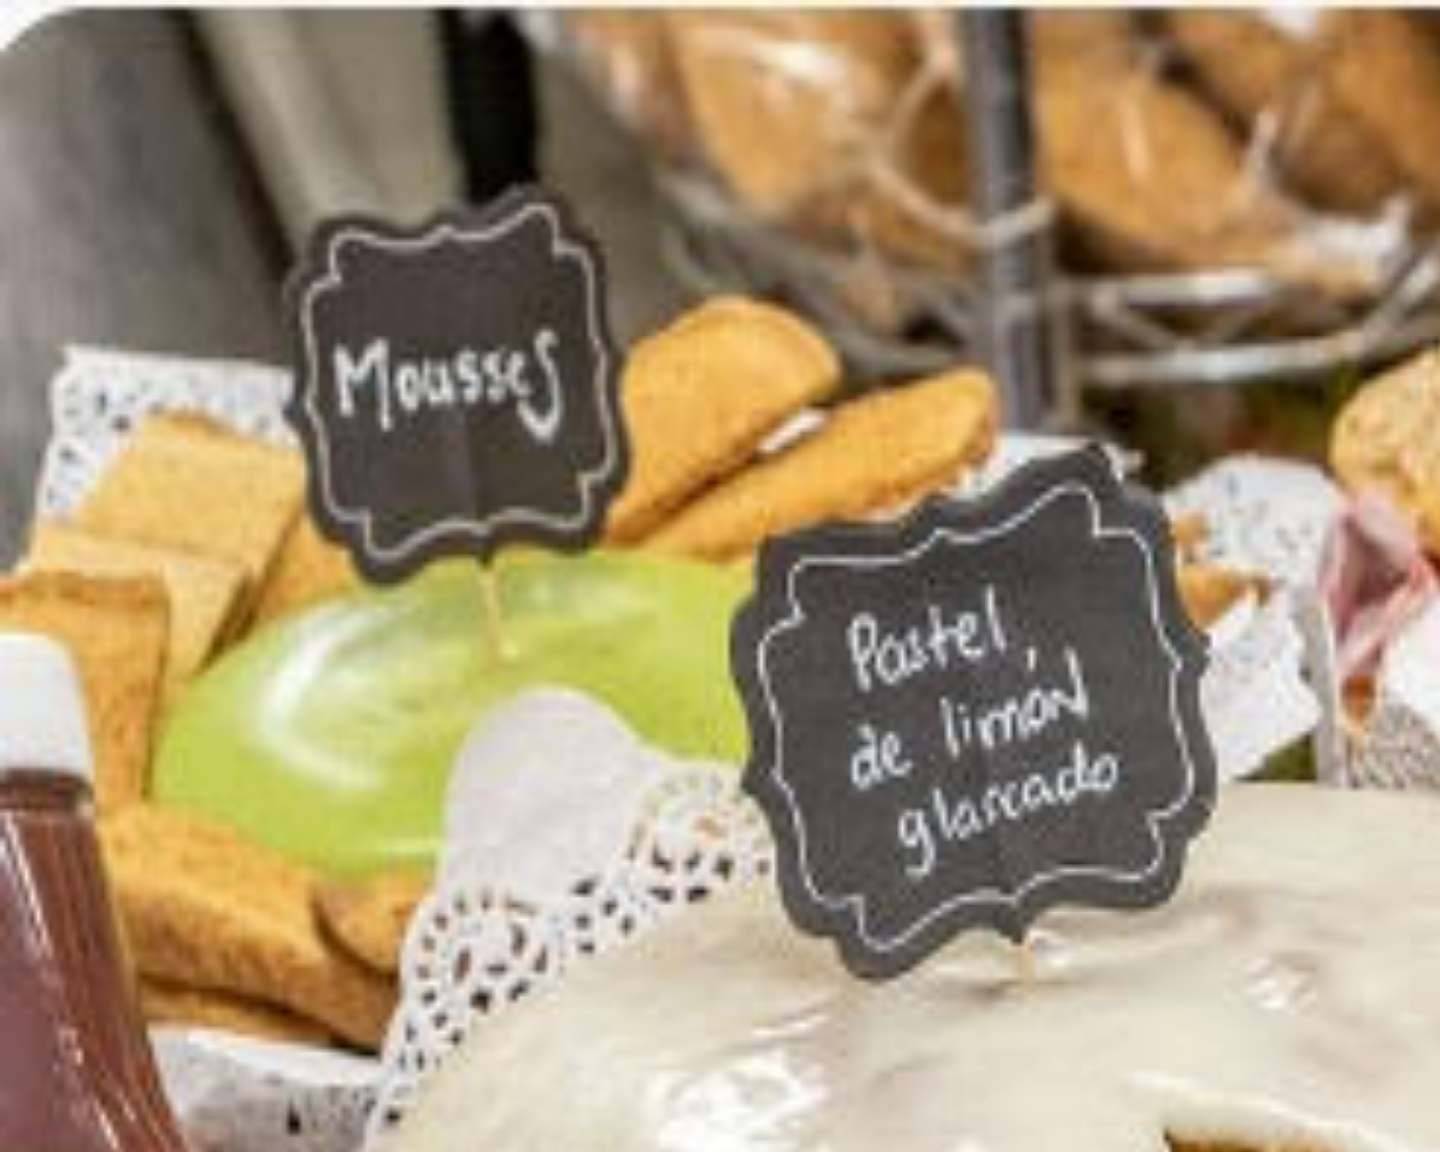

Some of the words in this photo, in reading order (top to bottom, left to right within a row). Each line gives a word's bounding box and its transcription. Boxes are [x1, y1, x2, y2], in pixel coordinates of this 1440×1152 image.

[332, 329, 563, 443] Mousses
[848, 583, 1007, 692] Pastel
[851, 724, 912, 790] de
